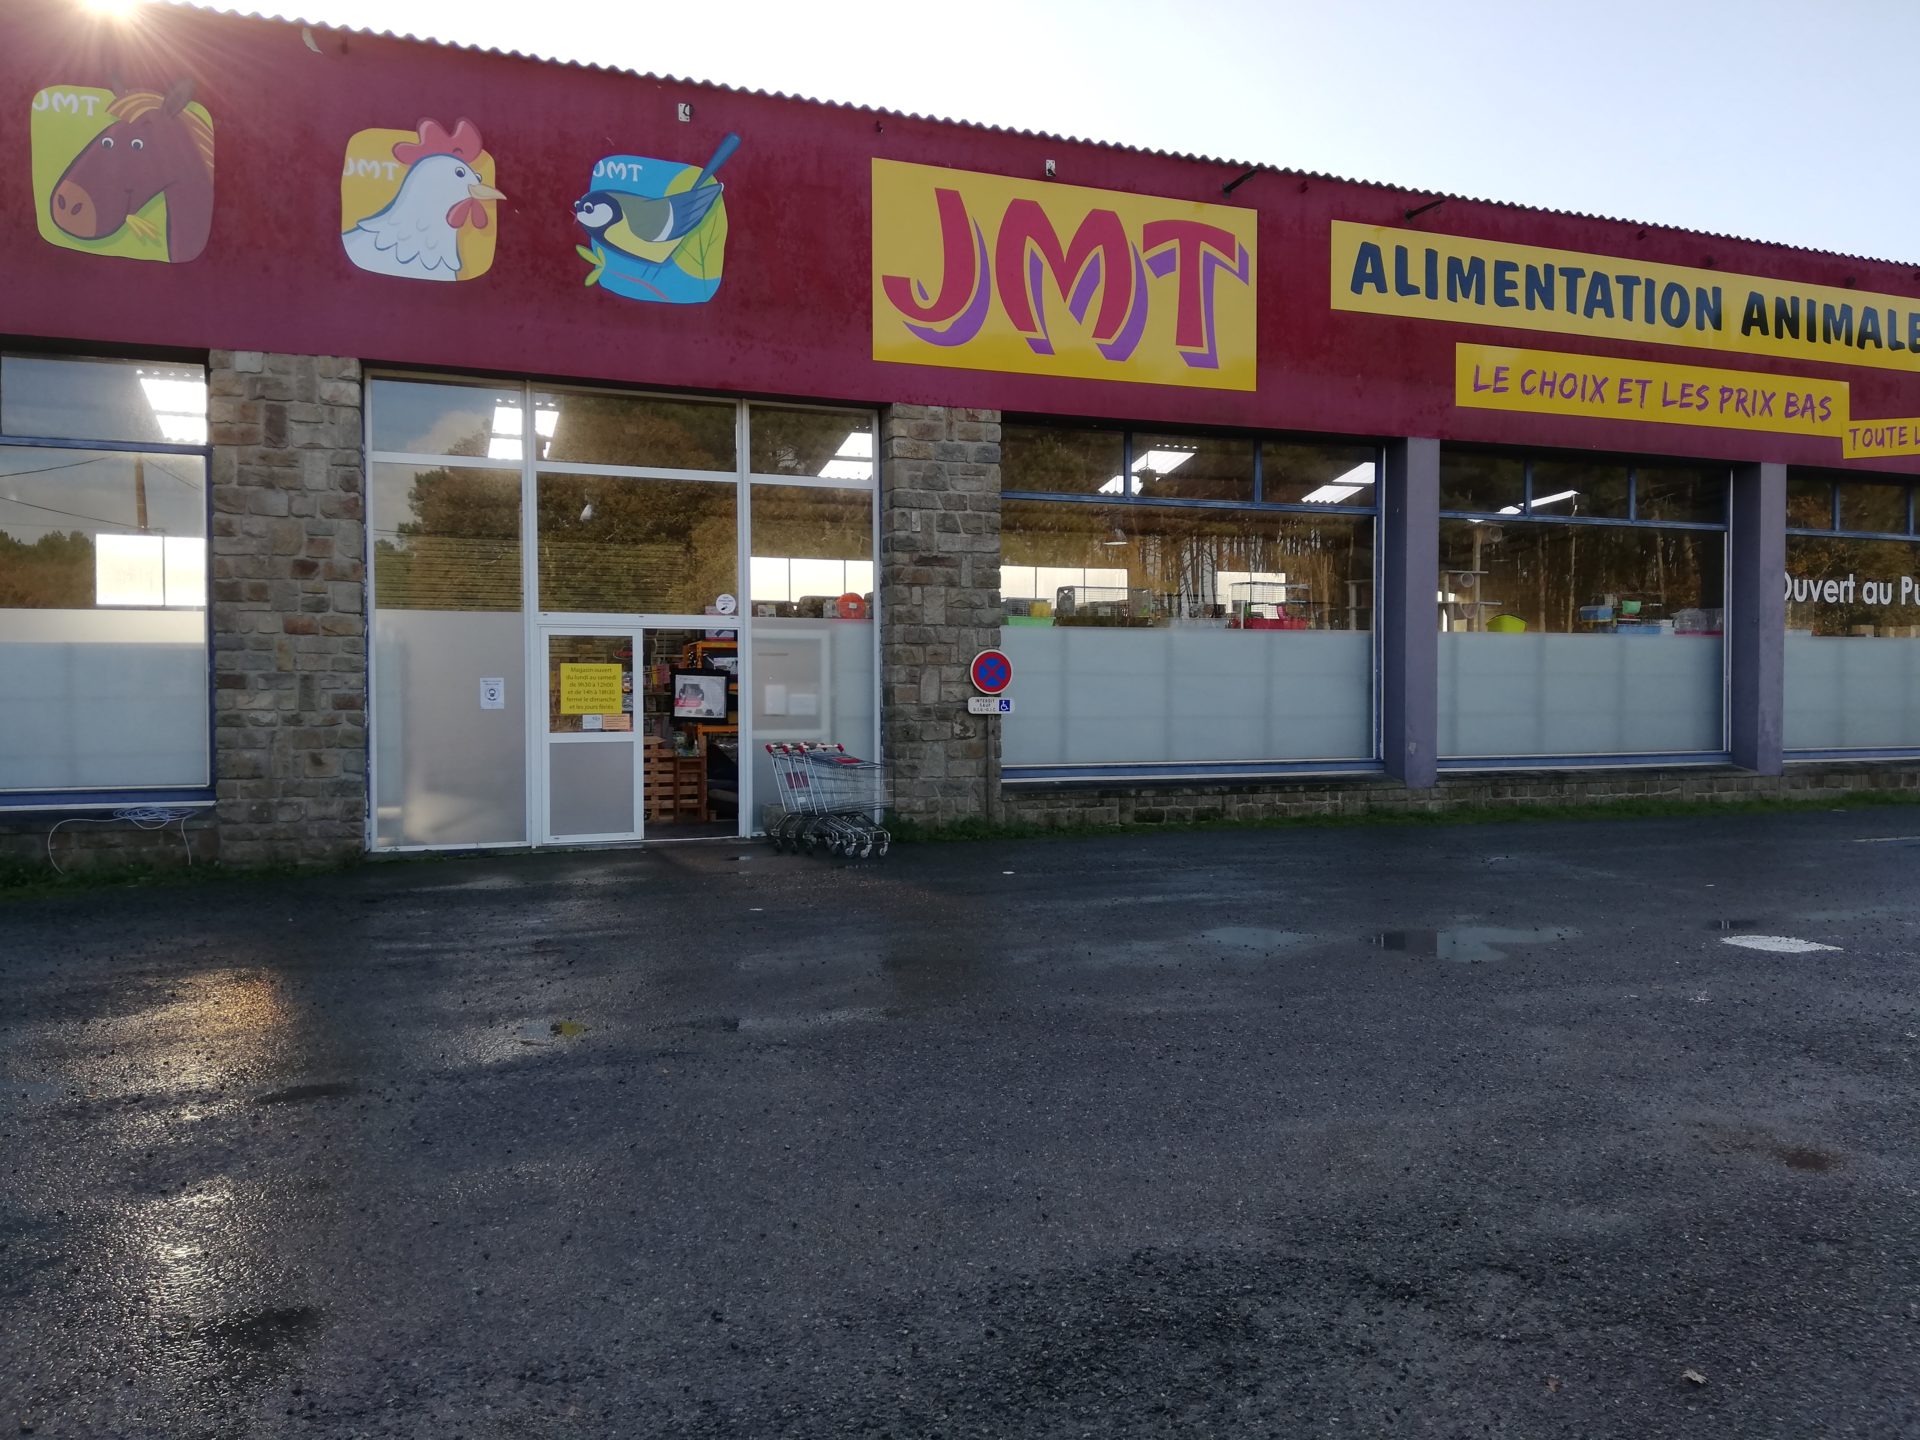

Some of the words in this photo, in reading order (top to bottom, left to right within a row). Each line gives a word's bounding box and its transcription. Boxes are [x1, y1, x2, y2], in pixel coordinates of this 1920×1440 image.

[32, 89, 100, 117] JMT
[343, 157, 400, 182] JMT
[592, 159, 644, 183] JMT
[881, 187, 1250, 370] JMT
[1350, 241, 1723, 331] ALIMENTATION
[1473, 364, 1509, 393] LE
[1520, 368, 1609, 404] CHOIX
[1617, 377, 1652, 409] ET
[1661, 381, 1710, 413] LES
[1719, 386, 1775, 419] PRIX
[1783, 392, 1833, 423] BAS
[1849, 425, 1908, 451] TOUTE
[1862, 580, 1892, 605] au
[570, 666, 594, 674] Magasin
